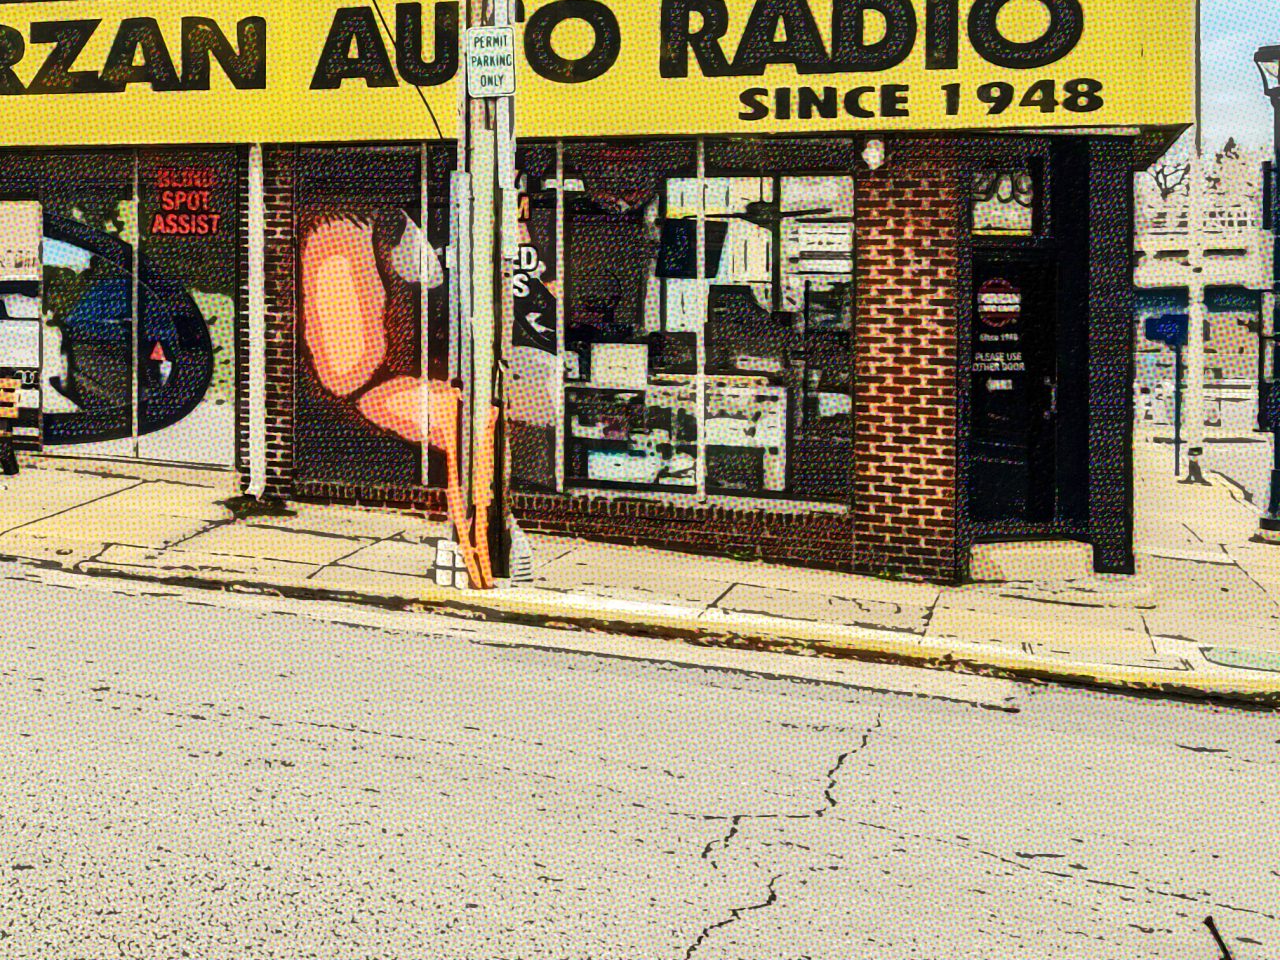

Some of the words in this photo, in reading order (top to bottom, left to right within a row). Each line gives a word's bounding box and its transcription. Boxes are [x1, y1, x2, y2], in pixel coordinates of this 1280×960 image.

[308, 0, 621, 91] AUO
[473, 34, 508, 49] PERMIT
[471, 53, 513, 67] PARKING
[480, 74, 504, 87] ONLY
[738, 83, 910, 122] SINCE
[941, 76, 1105, 116] 1948
[162, 190, 210, 211] SPOT
[152, 213, 221, 235] ASSIST
[974, 352, 1005, 361] PLEASE
[1007, 352, 1022, 361] USE
[972, 362, 1000, 371] OTHER
